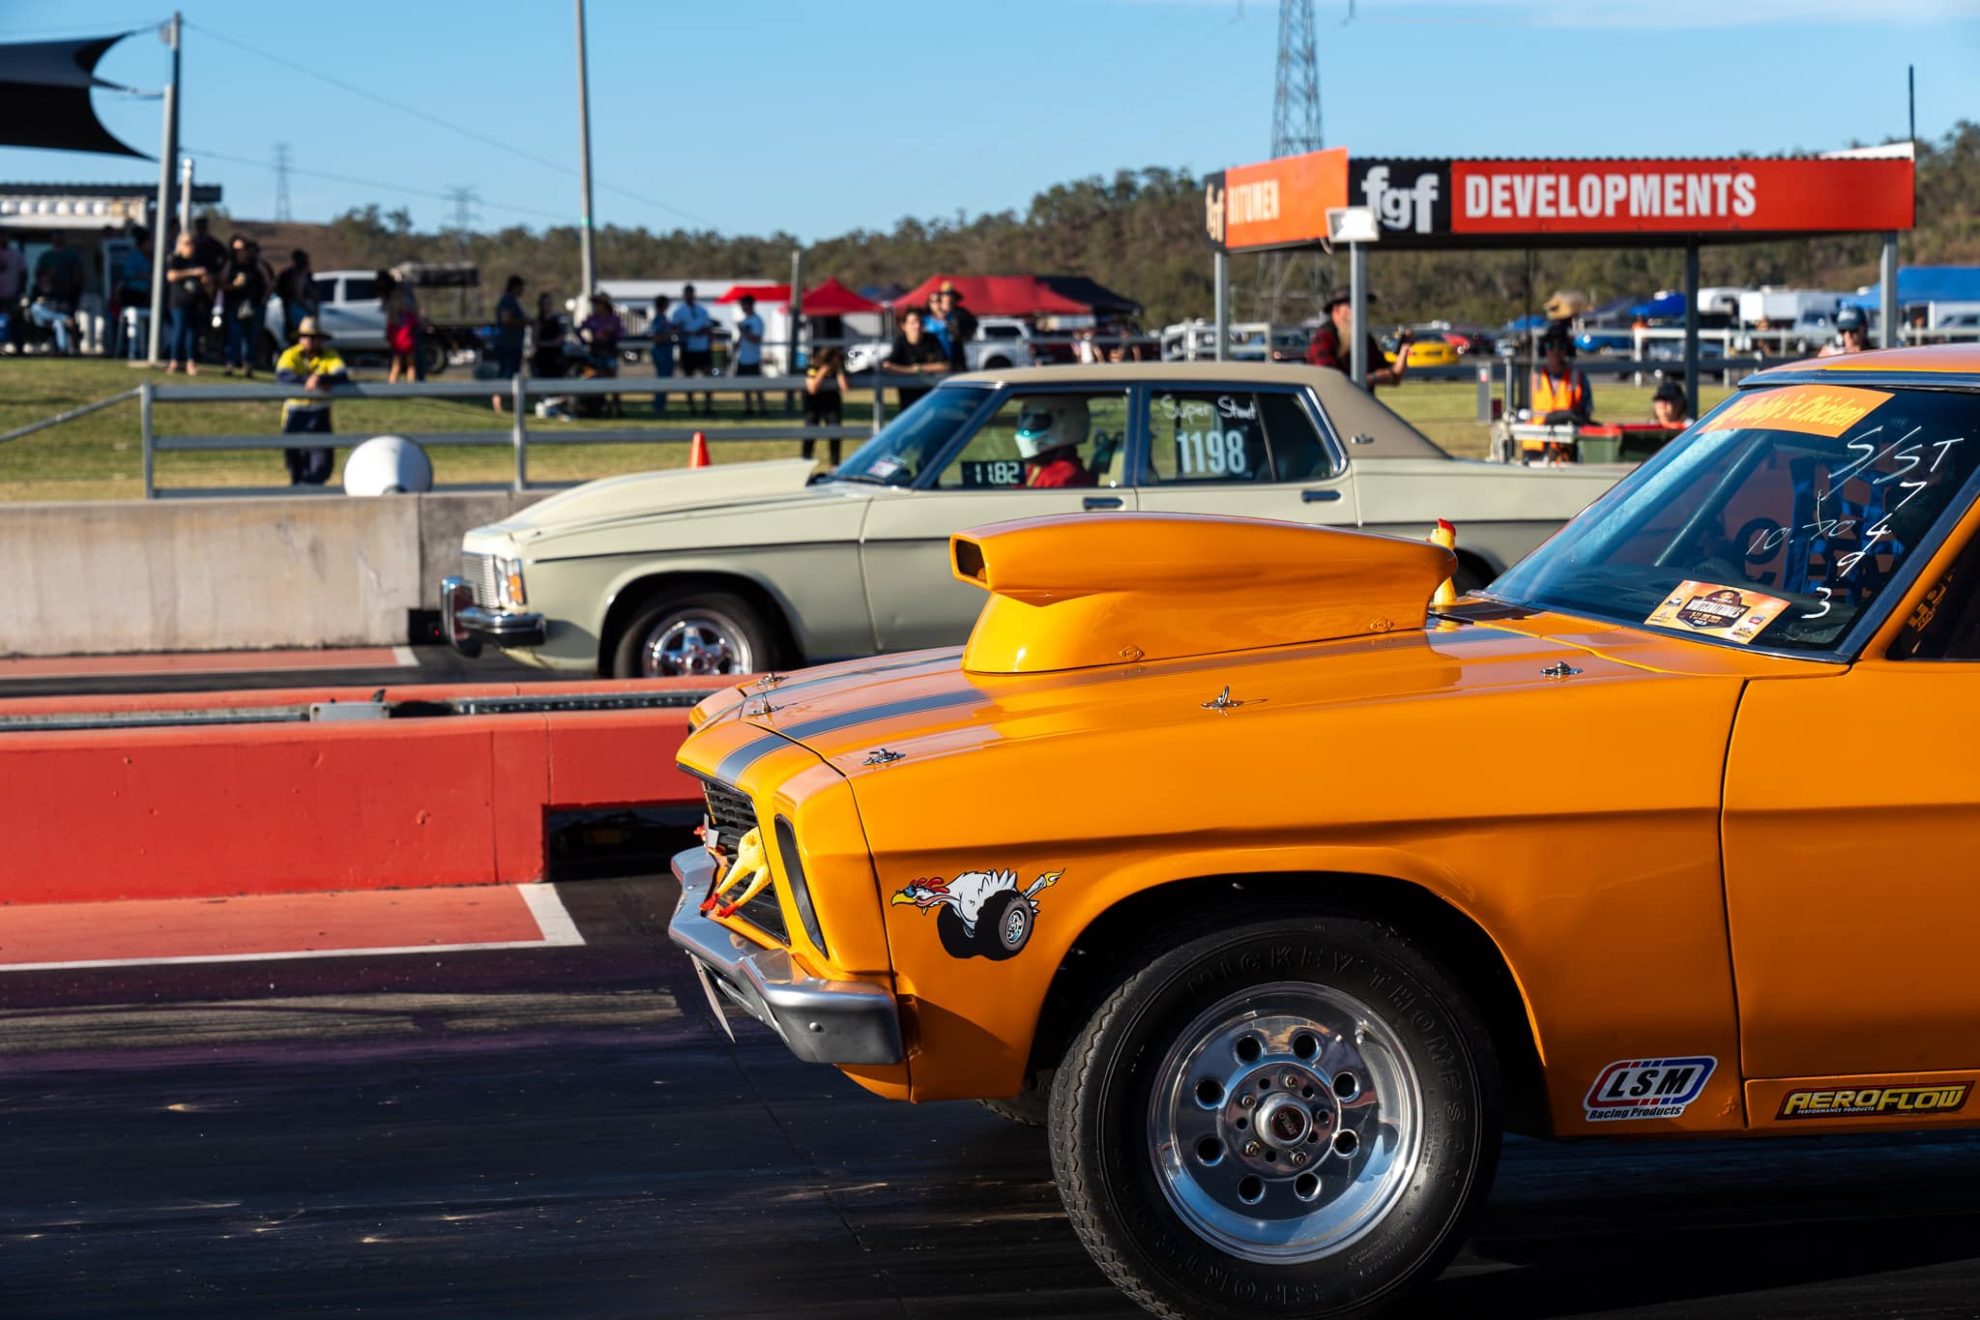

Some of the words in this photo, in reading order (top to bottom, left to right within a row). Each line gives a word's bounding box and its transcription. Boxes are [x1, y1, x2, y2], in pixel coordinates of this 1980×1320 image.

[1361, 165, 1439, 234] fgf
[1465, 173, 1757, 218] DEVELOPMENTS
[1176, 429, 1246, 475] 1198
[1605, 1067, 1696, 1098] LSM
[1589, 1108, 1630, 1120] Racing
[1629, 1106, 1682, 1118] Products
[1783, 1085, 1967, 1115] AEROFLOW
[1796, 1107, 1842, 1115] PERFORMANCE
